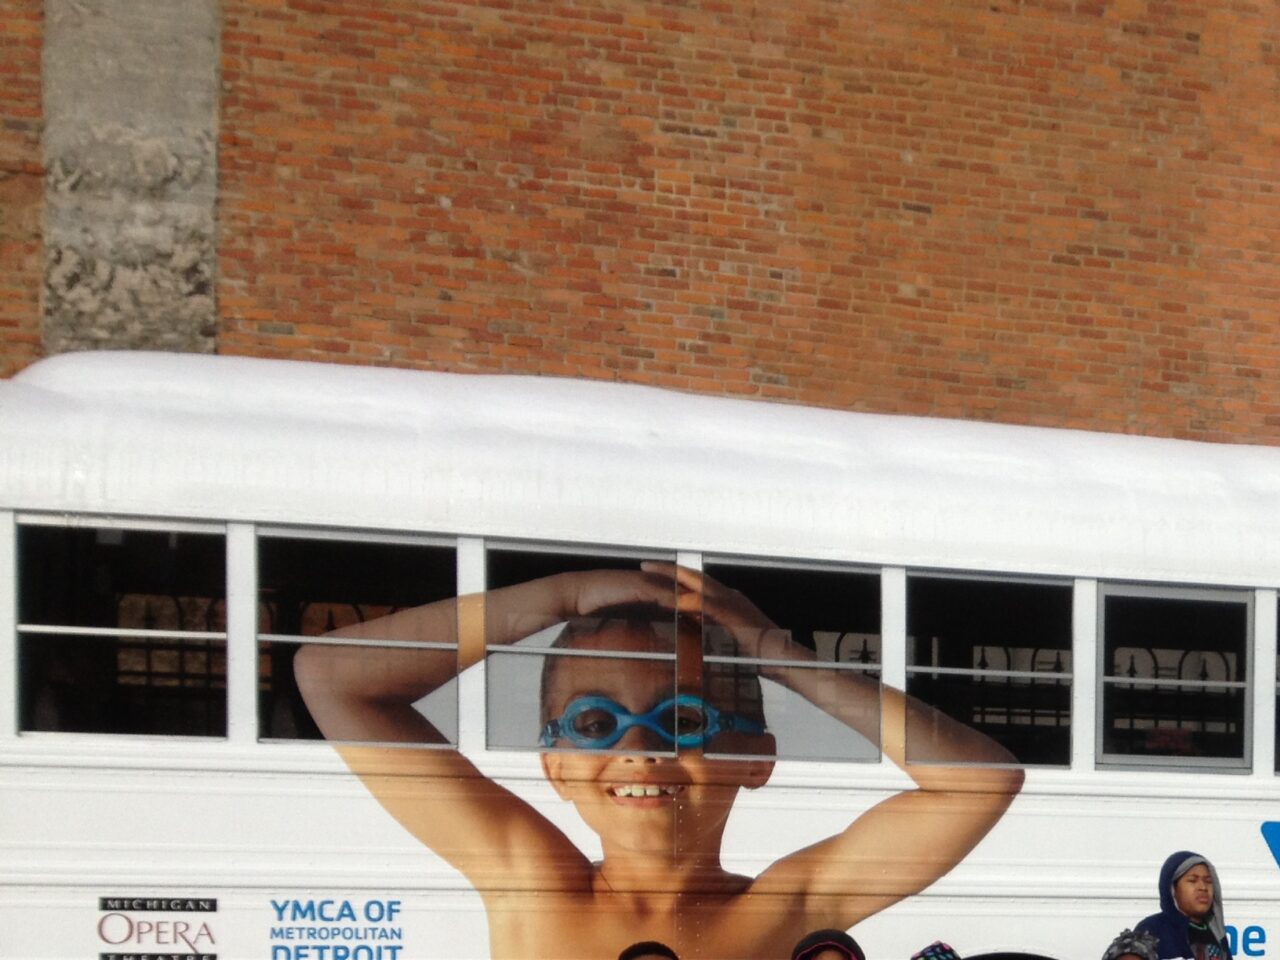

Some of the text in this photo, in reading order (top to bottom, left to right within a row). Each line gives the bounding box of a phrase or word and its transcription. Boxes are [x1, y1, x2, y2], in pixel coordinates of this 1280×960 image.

[106, 899, 211, 910] MICHIGAN
[271, 900, 401, 923] YMCA OF
[98, 912, 216, 954] OPERA
[271, 927, 402, 940] METROPOLITAN
